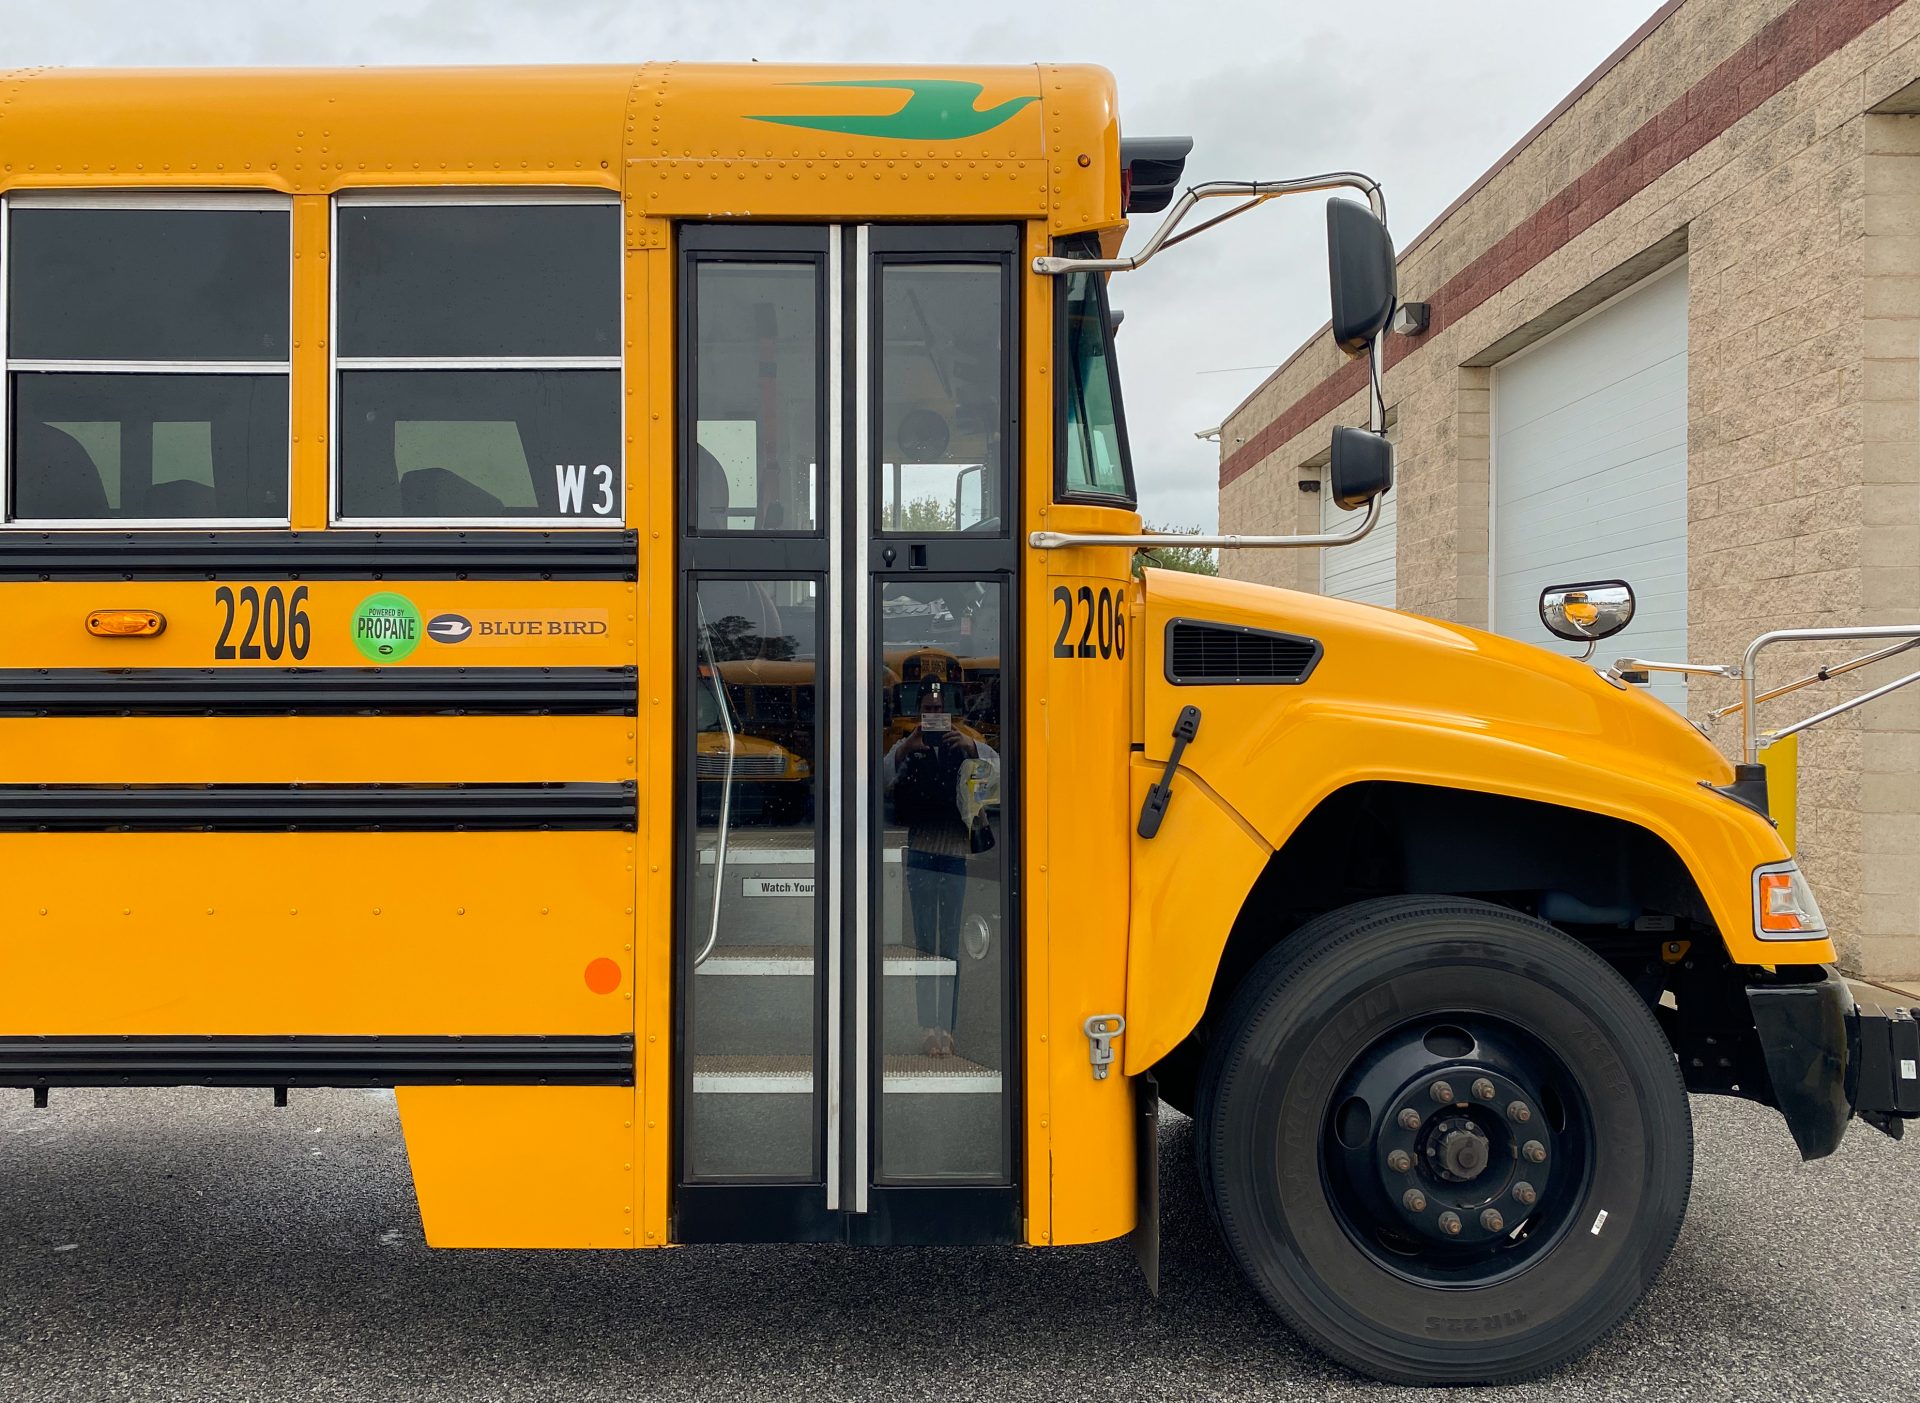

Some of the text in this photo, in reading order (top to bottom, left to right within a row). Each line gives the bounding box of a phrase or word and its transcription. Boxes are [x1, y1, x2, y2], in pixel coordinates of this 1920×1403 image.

[555, 464, 613, 514] W3
[215, 585, 310, 660] 2206
[358, 617, 415, 640] PROPANE
[368, 608, 396, 616] POWERED
[479, 621, 607, 635] BLUE BIRD
[1053, 585, 1125, 660] 2206
[761, 882, 814, 892] Watch Your
[1283, 985, 1391, 1148] MICHELIN
